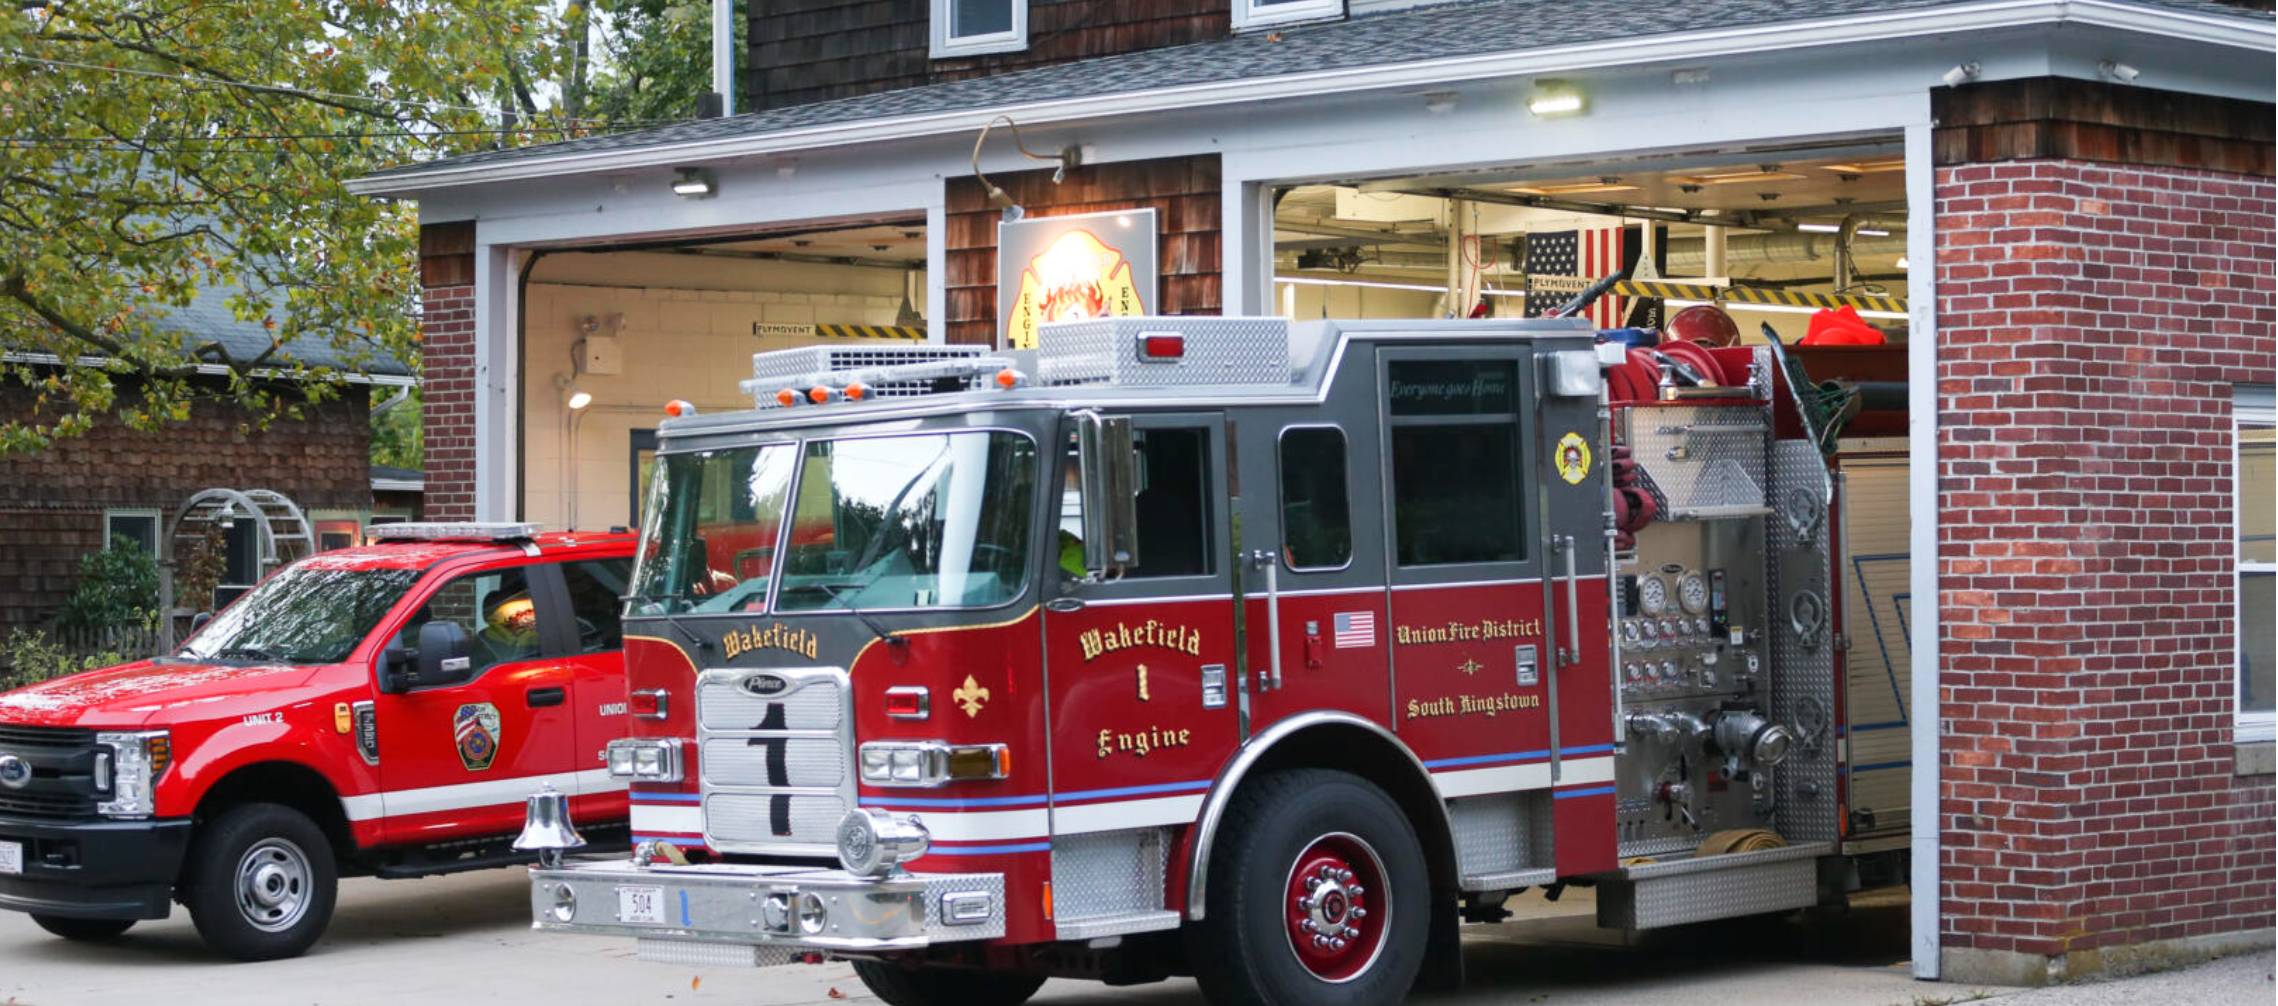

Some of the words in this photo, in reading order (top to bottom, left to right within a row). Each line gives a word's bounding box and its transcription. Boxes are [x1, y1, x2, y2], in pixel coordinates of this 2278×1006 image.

[1534, 278, 1591, 289] PLYMOVENT
[1121, 286, 1129, 316] EN
[722, 622, 818, 661] Wakefield
[1080, 619, 1201, 661] Wakefield
[1396, 625, 1447, 645] Union
[1448, 621, 1479, 641] Fire
[1482, 618, 1541, 641] District
[242, 712, 272, 727] UNIT
[275, 711, 284, 723] 2
[1407, 696, 1454, 719] South
[1459, 691, 1540, 717] Kingstown
[1097, 725, 1190, 758] Engine
[747, 702, 792, 836] 1
[632, 893, 652, 914] 504
